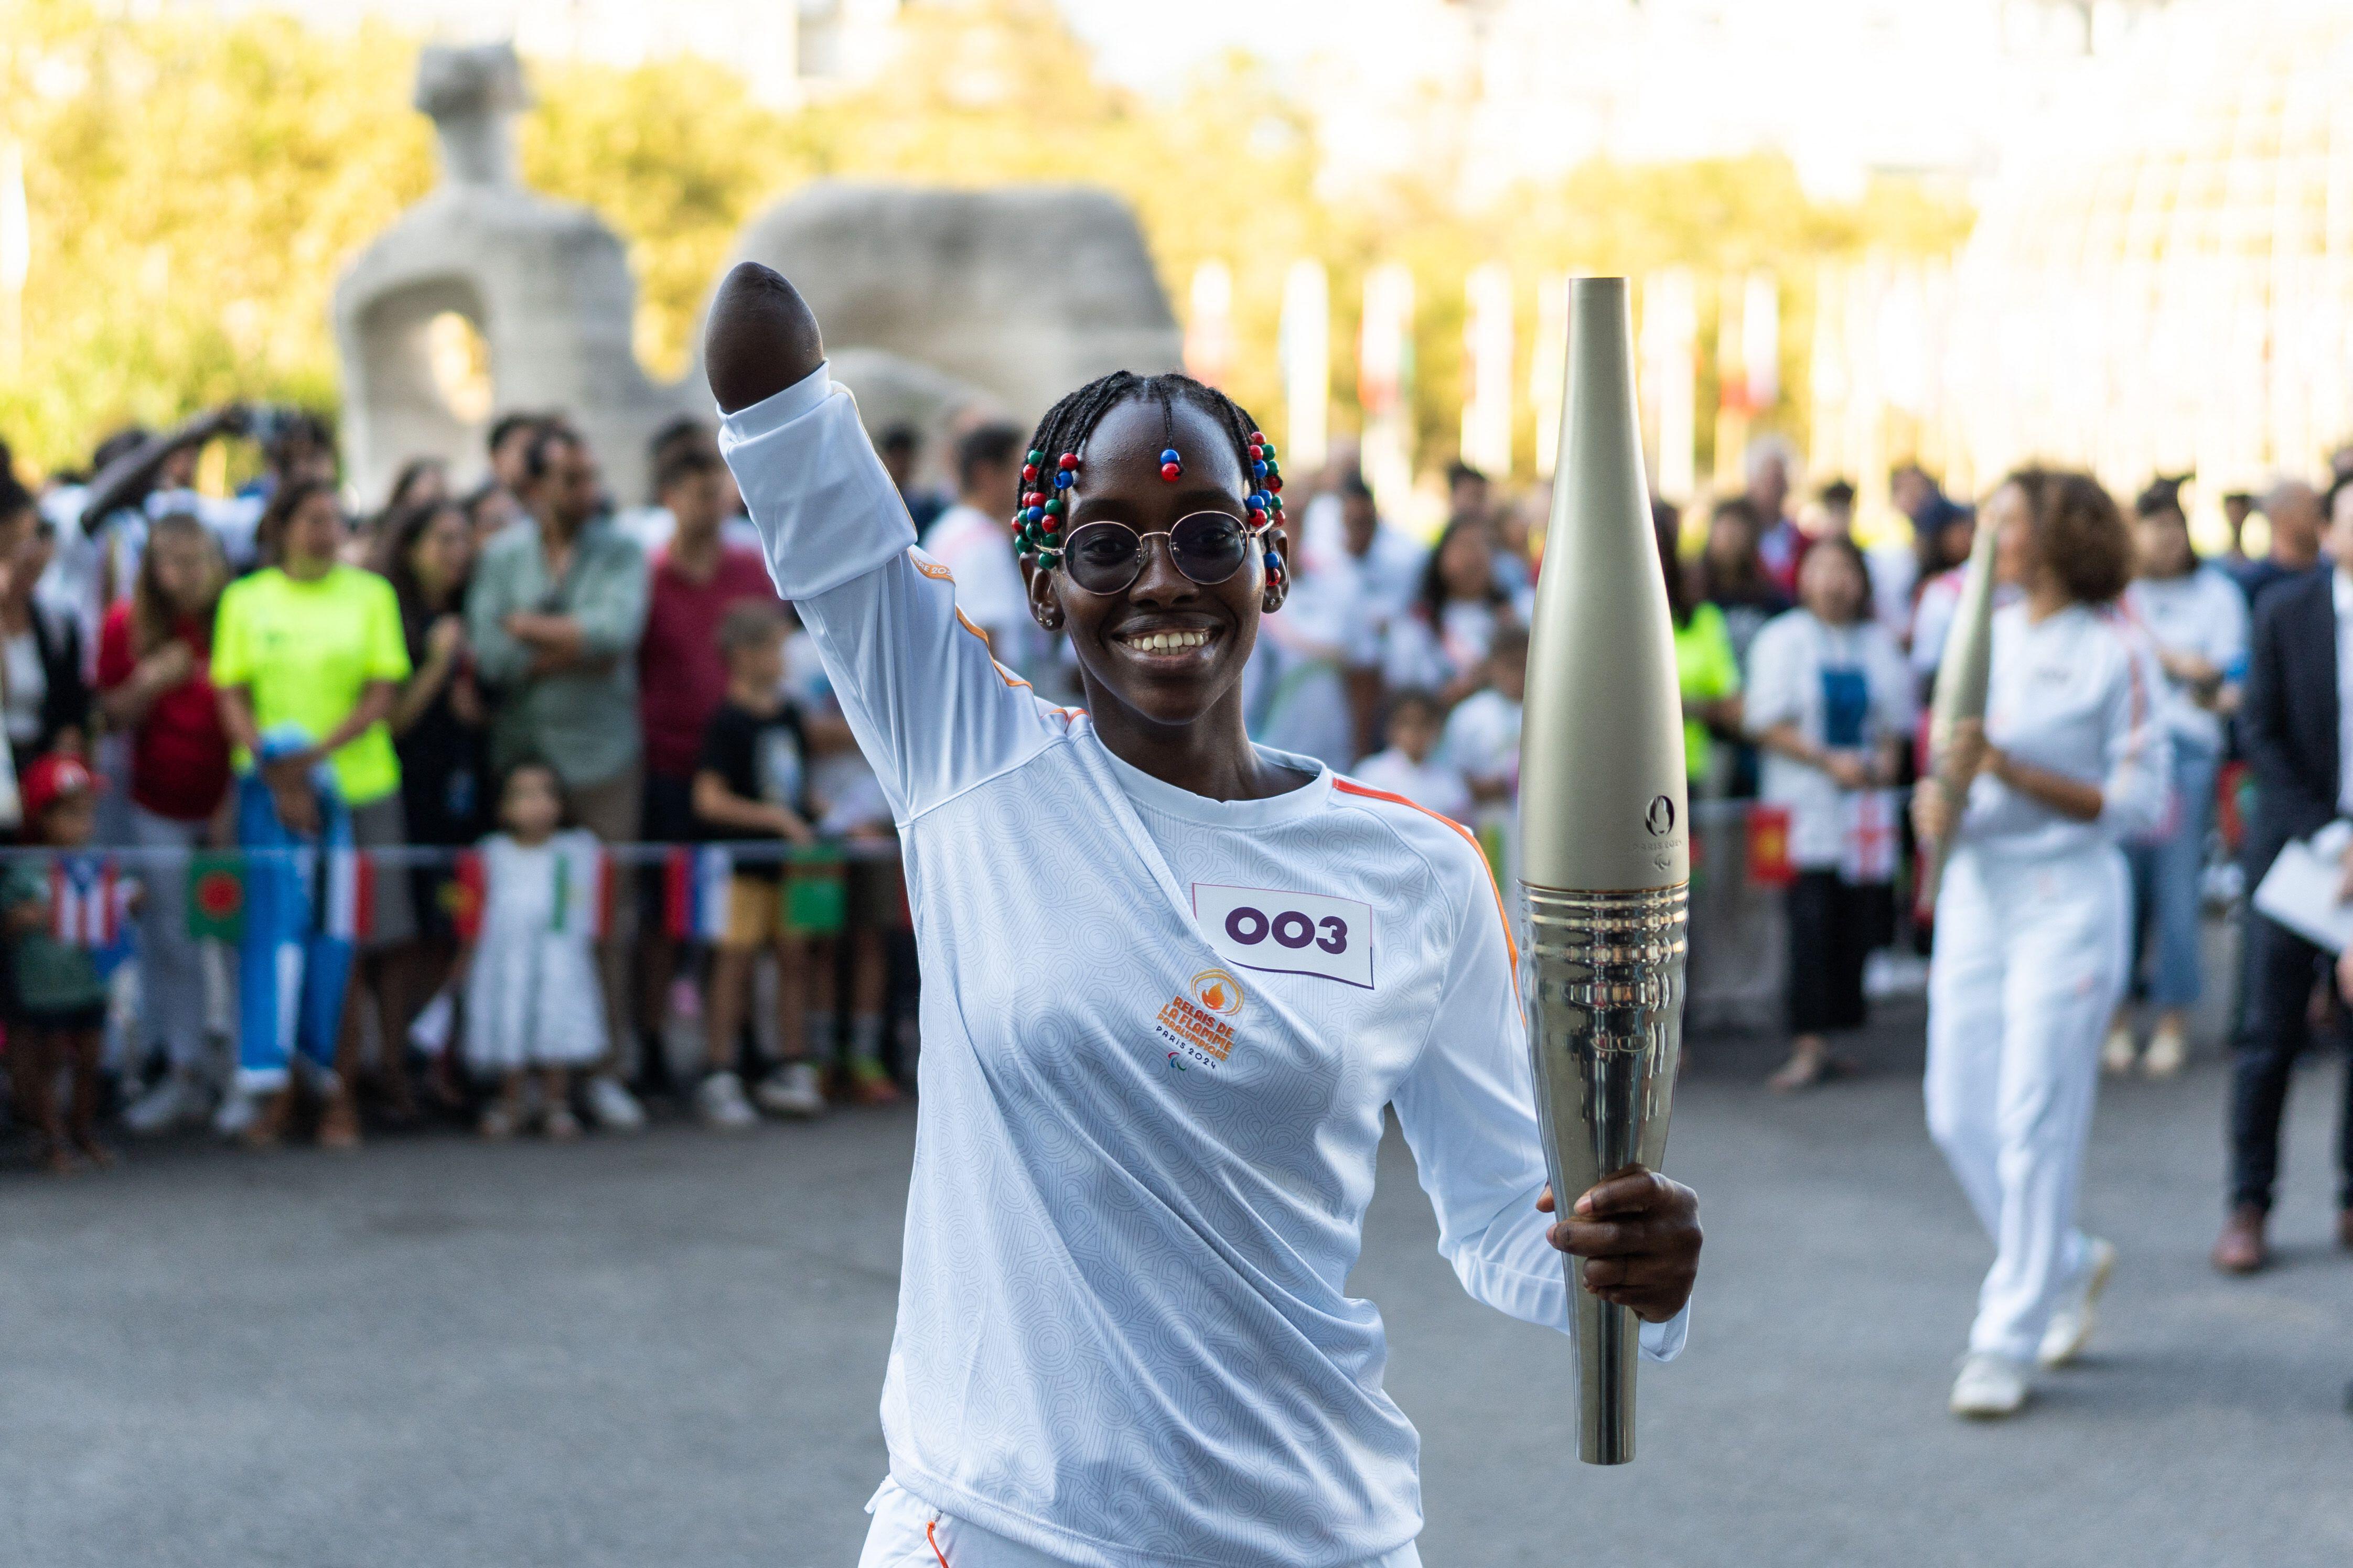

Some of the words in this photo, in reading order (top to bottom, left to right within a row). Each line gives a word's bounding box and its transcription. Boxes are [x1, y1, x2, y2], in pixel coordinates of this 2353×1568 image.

[1225, 906, 1348, 955] 003
[1156, 1012, 1229, 1062] PARALYMPIQUE
[1161, 1003, 1179, 1020] LA
[1178, 1013, 1234, 1052] FLAMME
[1172, 995, 1216, 1028] RELAIS
[1216, 1022, 1235, 1039] DE
[1188, 1048, 1216, 1069] 2024
